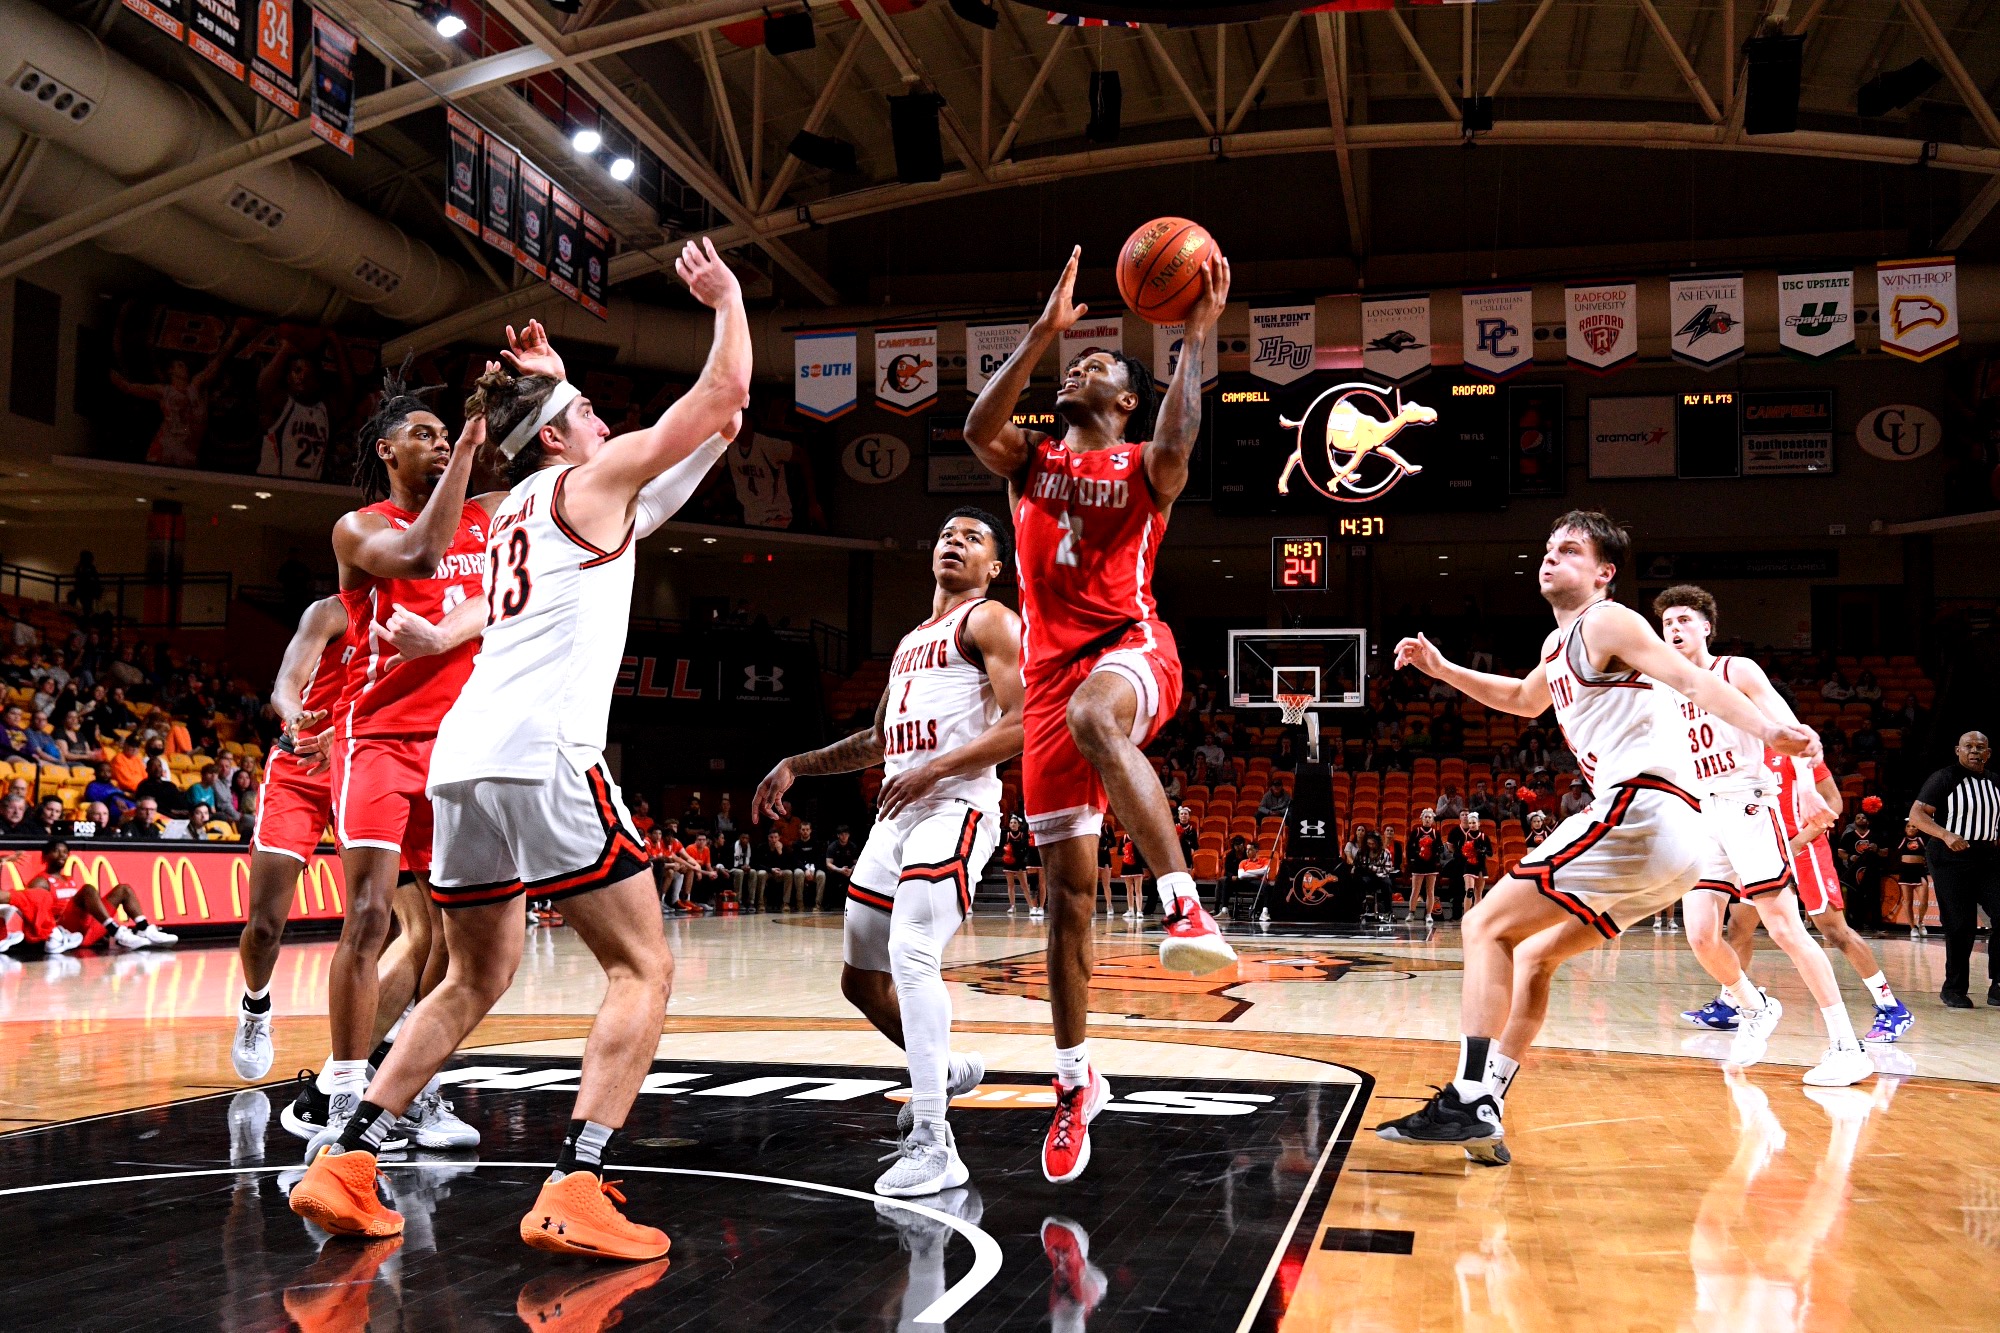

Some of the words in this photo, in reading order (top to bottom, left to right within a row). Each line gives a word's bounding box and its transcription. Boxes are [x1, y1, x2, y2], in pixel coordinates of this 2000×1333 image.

[264, 1, 288, 60] 34
[1783, 281, 1804, 290] USC
[1806, 278, 1850, 289] UPSTATE
[1882, 272, 1952, 286] WINTHROP
[1470, 296, 1523, 305] PRESBYTERIAN
[1574, 291, 1626, 302] RADFORD
[1677, 289, 1737, 301] ASHEVILLE
[1574, 301, 1626, 311] UNIVERSITY
[1254, 315, 1278, 324] HIGH
[1280, 313, 1311, 322] POINT
[1367, 307, 1425, 318] LONGWOOD
[1579, 314, 1624, 331] RADFORD
[1785, 313, 1848, 328] Spartans
[975, 328, 1021, 337] CHARLESTON
[877, 336, 936, 349] CAMPBELL
[978, 342, 1018, 350] UNIVERSITY
[979, 336, 1017, 344] SOUTHERN
[1253, 336, 1312, 369] HPU
[800, 362, 852, 378] SOUTH
[1452, 384, 1497, 396] RADFORD
[1221, 391, 1270, 403] CAMPBELL
[1684, 395, 1700, 405] PLY
[1703, 395, 1714, 405] FL
[1715, 394, 1733, 404] PTS
[1746, 403, 1828, 419] CAMPBELL
[1012, 415, 1027, 425] PLY
[1028, 415, 1039, 424] FL
[1040, 414, 1055, 424] PTS
[1595, 431, 1648, 443] aramark
[1873, 409, 1925, 456] CU
[1748, 438, 1828, 450] Southeastern
[855, 438, 896, 478] CU
[1778, 450, 1826, 460] Interiors
[1032, 472, 1130, 509] RADORD
[1340, 517, 1384, 536] 14:37
[1056, 509, 1084, 568] 2
[1284, 541, 1322, 558] 14:37
[1283, 558, 1317, 585] 24
[1688, 723, 1714, 754] 30
[1693, 750, 1736, 780] AMELS
